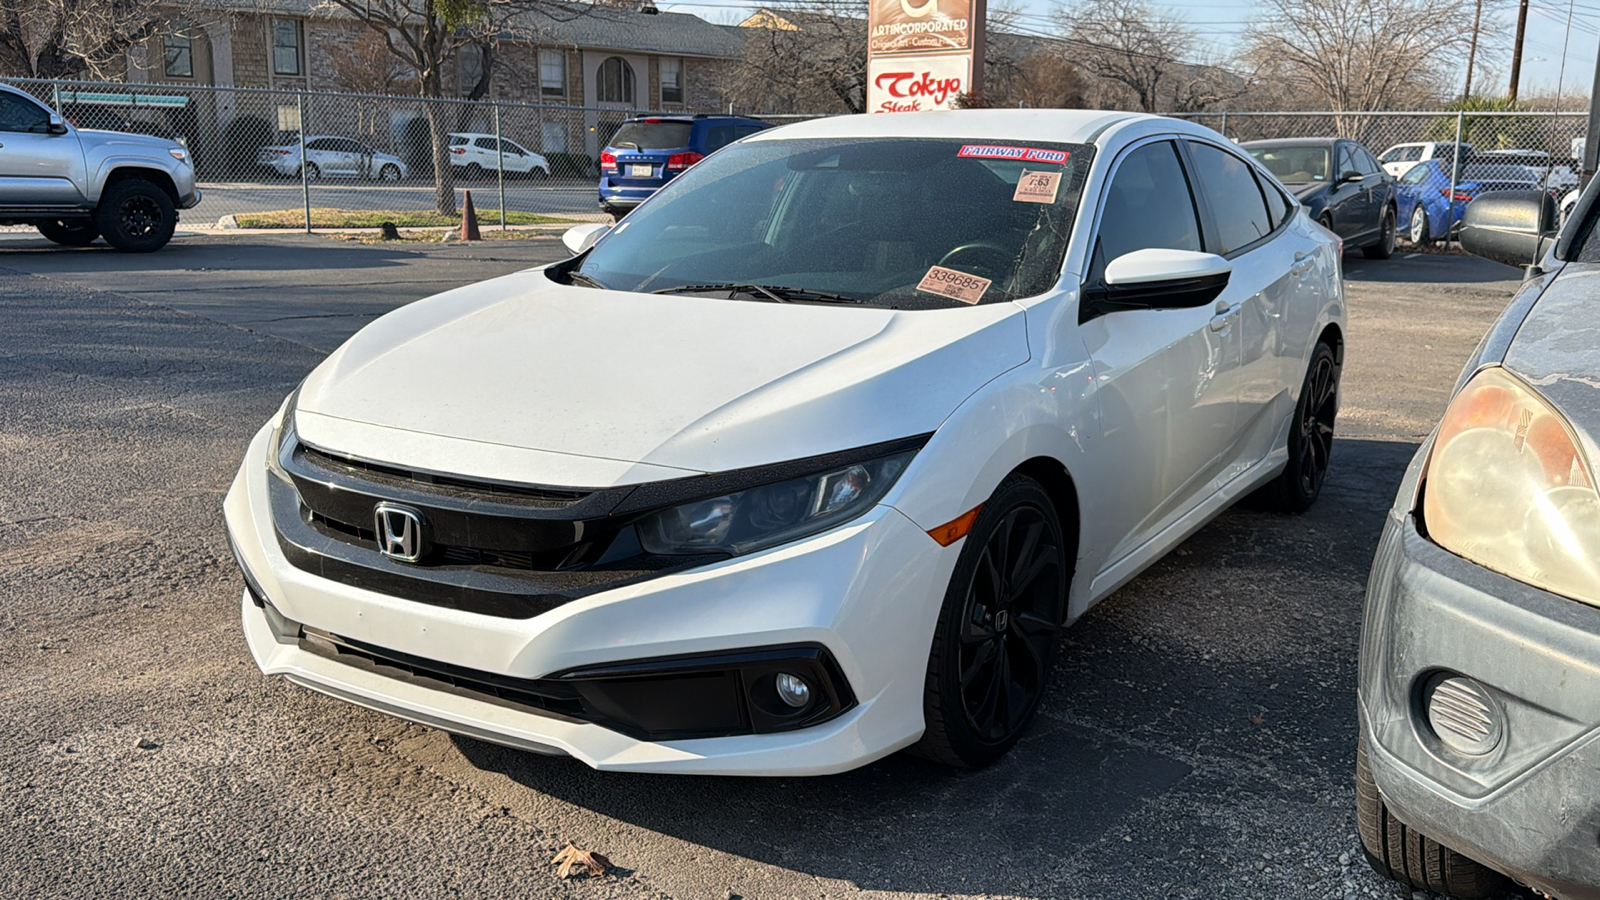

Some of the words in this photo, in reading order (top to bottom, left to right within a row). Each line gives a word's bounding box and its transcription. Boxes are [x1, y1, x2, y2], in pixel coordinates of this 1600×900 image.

[871, 19, 968, 37] ARTINCORPORATED
[875, 71, 961, 105] Tokyo
[881, 99, 921, 112] Steak
[963, 146, 1026, 158] FAIRWAY
[1026, 149, 1065, 161] FORD
[928, 269, 989, 292] 3396851
